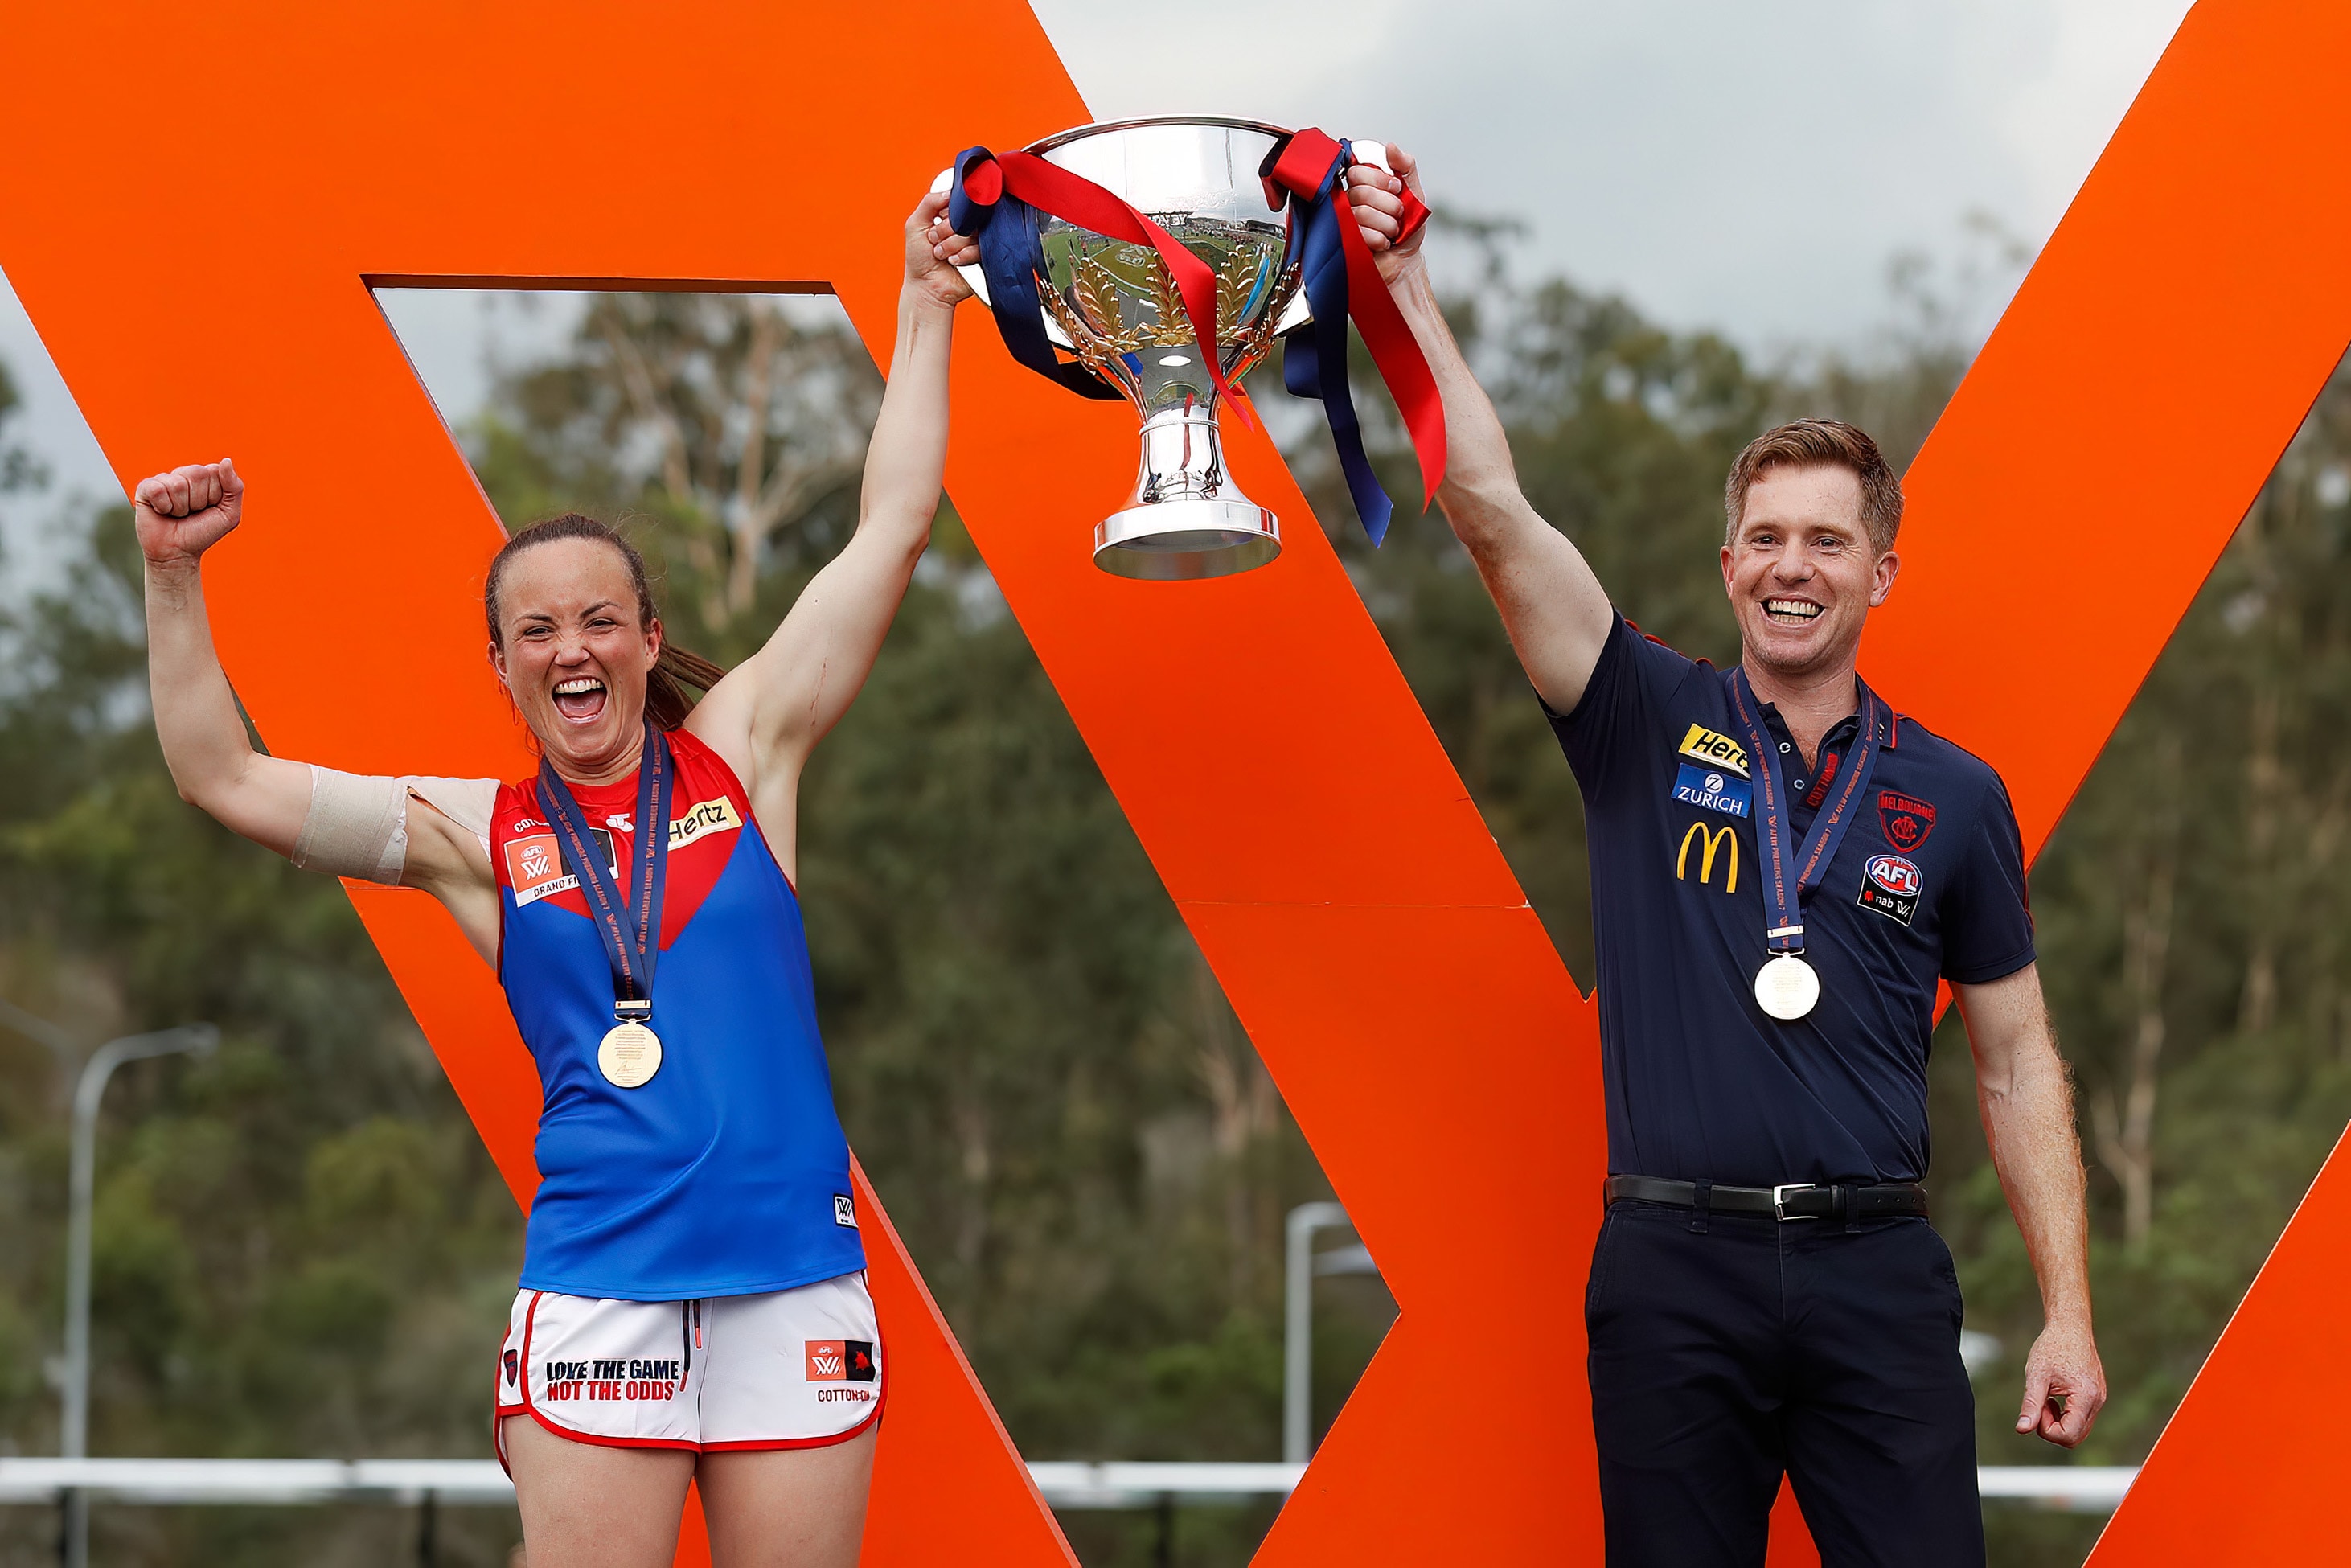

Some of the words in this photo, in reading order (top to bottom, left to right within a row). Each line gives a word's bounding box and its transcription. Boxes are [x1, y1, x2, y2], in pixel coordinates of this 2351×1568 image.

[1677, 786, 1743, 815] ZURICH
[1880, 796, 1935, 822] MELBOURNE
[669, 805, 727, 842] Hertz
[1872, 860, 1918, 892] AFL
[1876, 896, 1894, 909] nab
[546, 1361, 588, 1381] LOVE
[593, 1360, 626, 1379] THE
[630, 1359, 679, 1379] GAME
[547, 1381, 583, 1401] NOT
[587, 1381, 622, 1401] THE
[626, 1381, 675, 1401] ODDS
